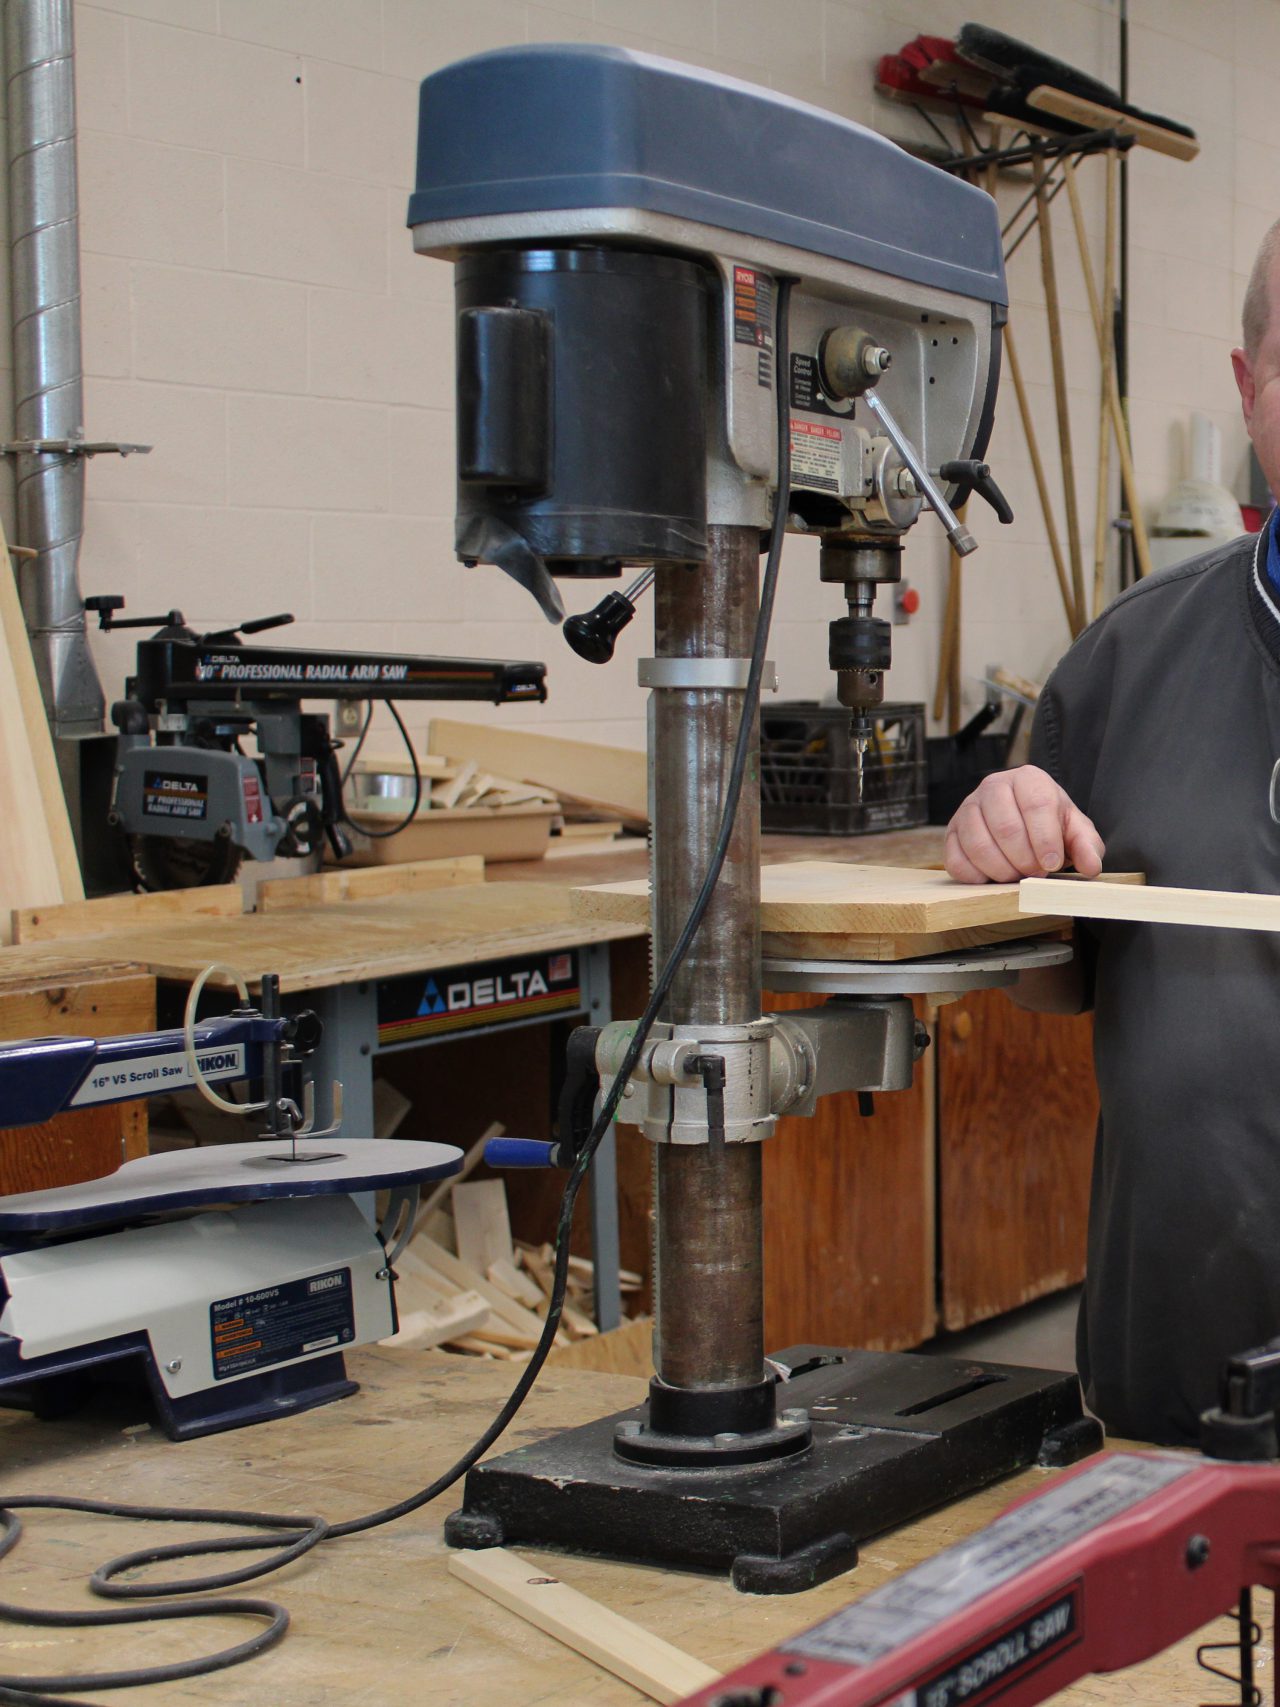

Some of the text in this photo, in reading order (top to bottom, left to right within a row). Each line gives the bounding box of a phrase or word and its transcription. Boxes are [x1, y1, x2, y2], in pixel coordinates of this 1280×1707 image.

[221, 664, 302, 680] PROFESSIONAL
[305, 664, 349, 680] RADIAL
[350, 664, 379, 680] ARM
[382, 664, 408, 680] SAW
[162, 780, 199, 792] DELTA
[447, 969, 549, 1011] DELTA
[92, 1066, 183, 1089] 16" VS Scroll Saw
[309, 1274, 343, 1293] RIKON
[213, 1300, 237, 1312] Model
[955, 1631, 1030, 1697] SCROLL
[1029, 1601, 1071, 1650] SAW
